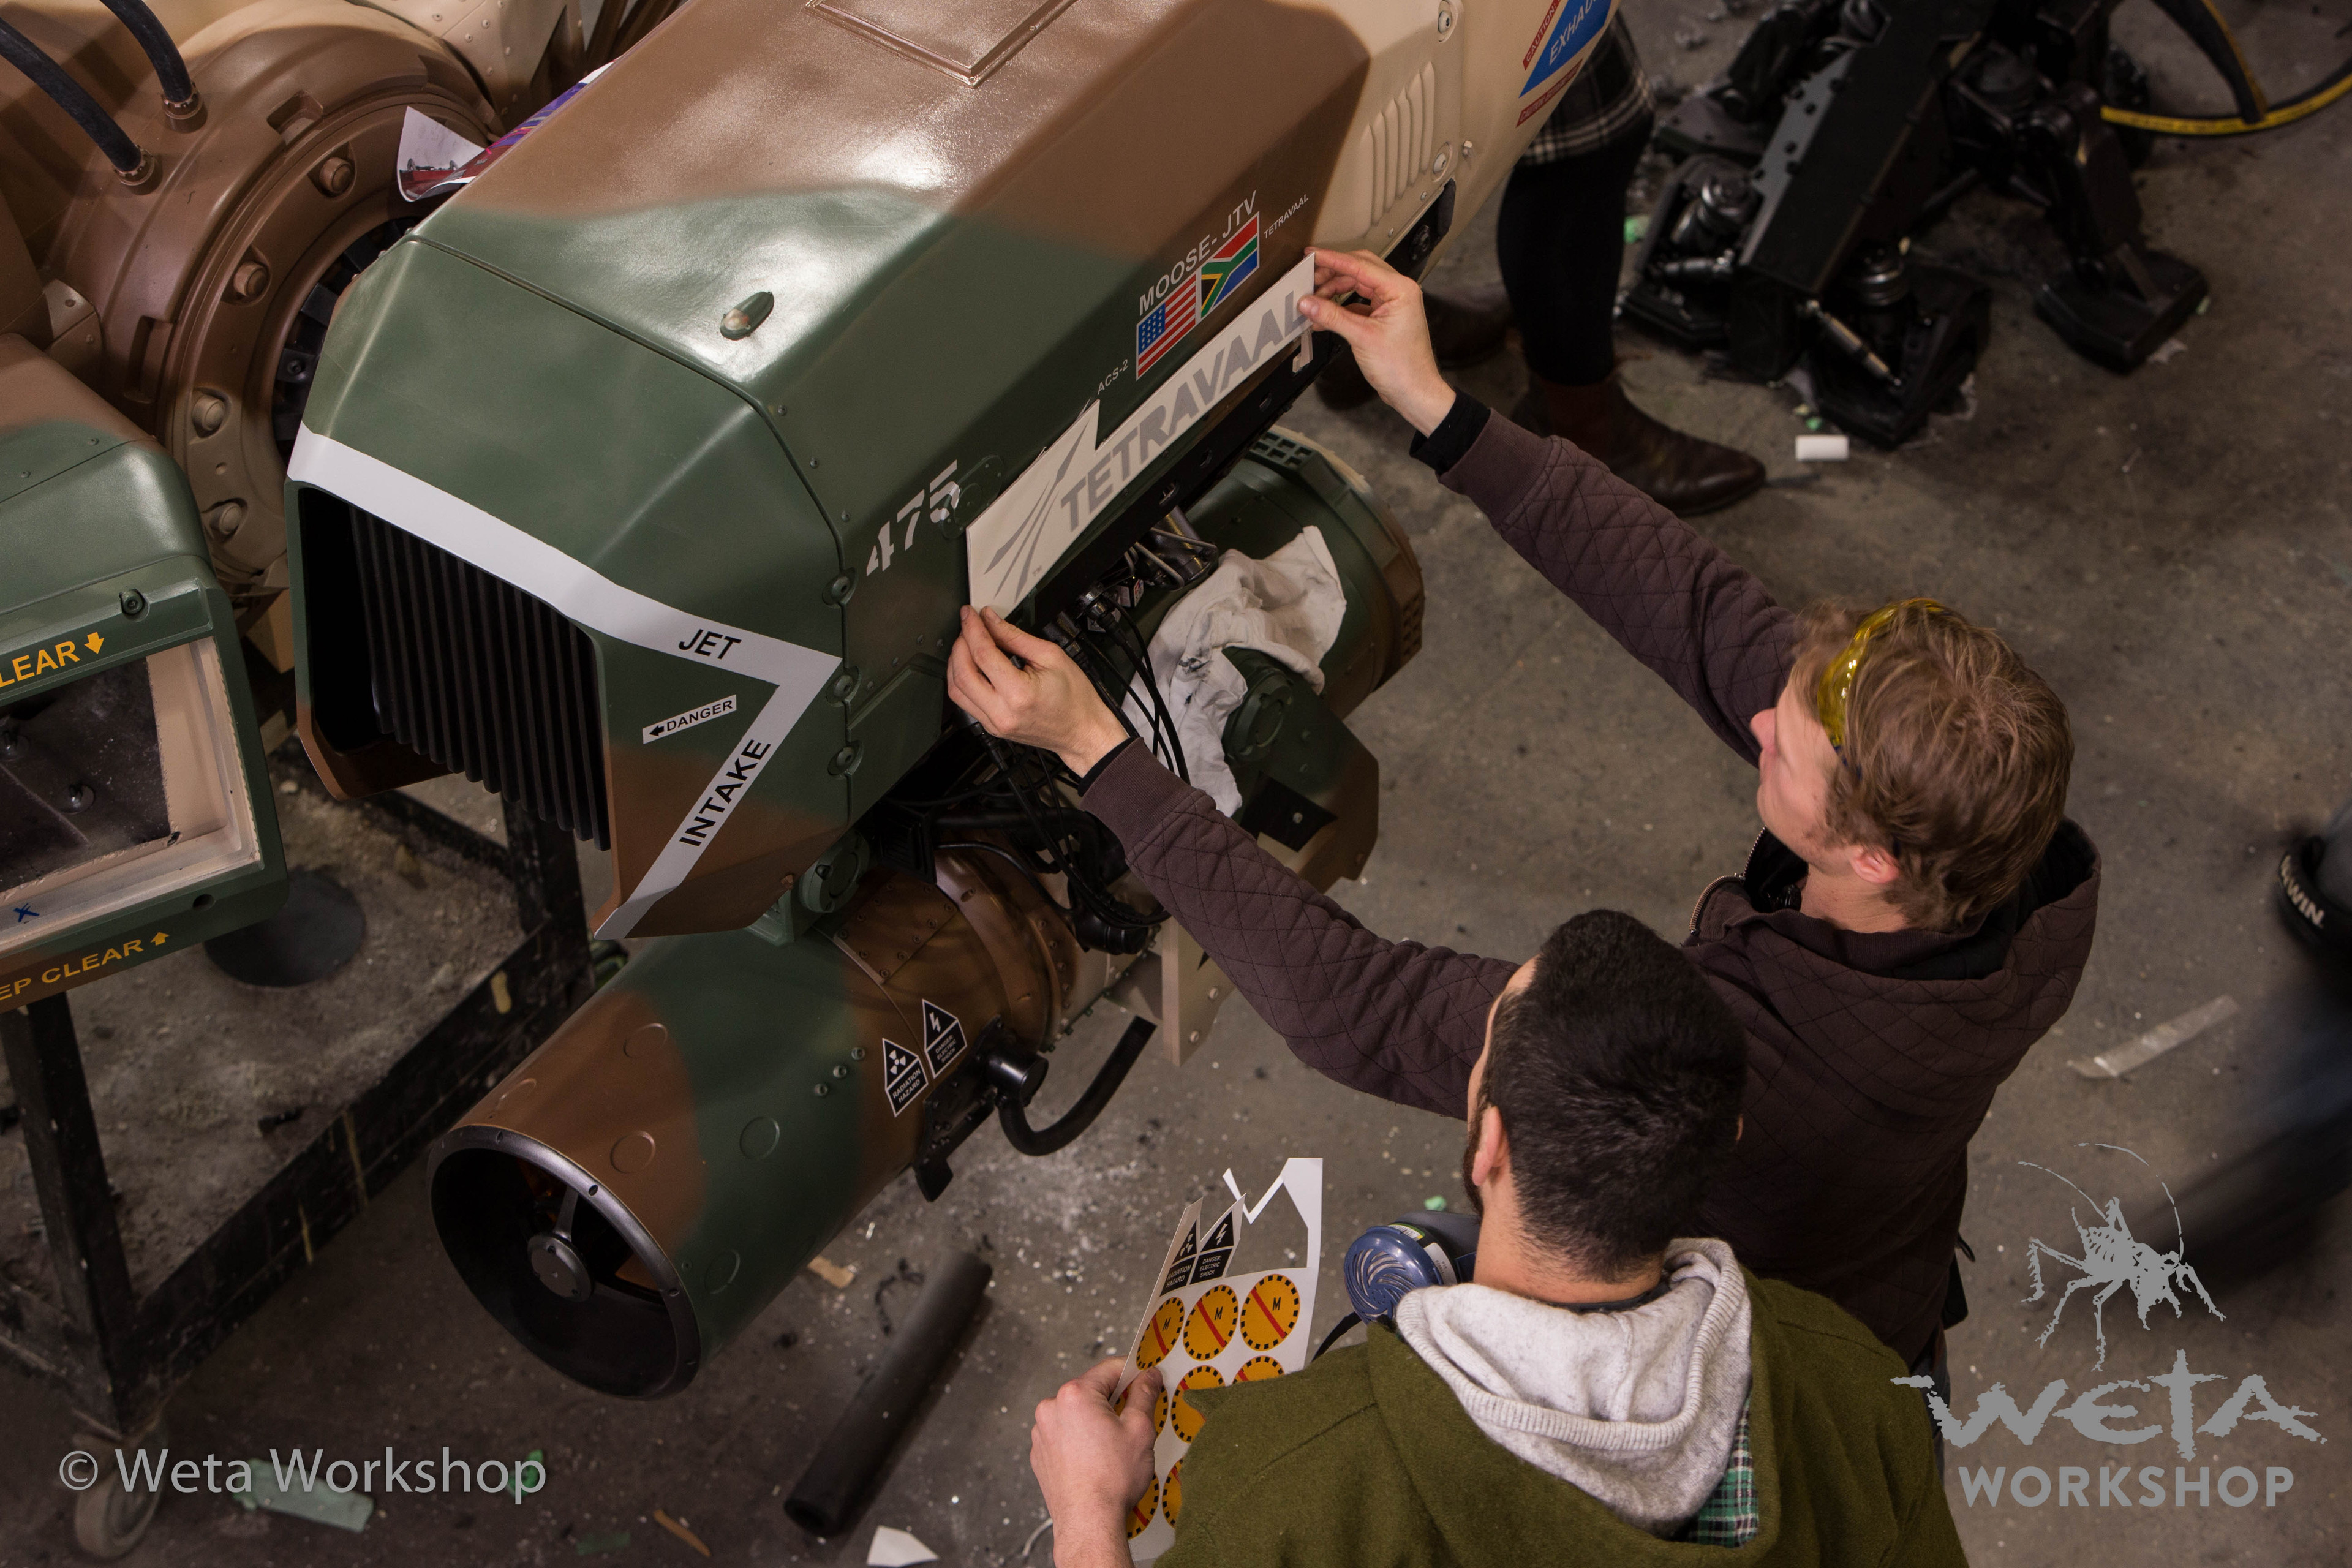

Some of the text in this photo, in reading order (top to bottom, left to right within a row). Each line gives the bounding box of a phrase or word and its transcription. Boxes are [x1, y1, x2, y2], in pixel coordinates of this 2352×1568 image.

[1526, 2, 1557, 62] CAUTION:
[1549, 0, 1596, 66] EXHAU
[1264, 194, 1309, 239] TETRAVAAL
[1097, 359, 1128, 395] ACS-2
[1061, 291, 1310, 532] TETRAVAAL
[866, 459, 960, 576] 475
[678, 629, 742, 660] JET
[666, 699, 733, 732] DANGER
[679, 739, 771, 846] INTAKE
[42, 940, 144, 984] CLEAR
[892, 1068, 921, 1099] RADIATION
[899, 1079, 920, 1103] HAZARD
[1166, 1275, 1185, 1287] HAZARD
[1167, 1264, 1191, 1280] RADIATION
[1199, 1262, 1220, 1272] ELECTRIC
[1215, 1306, 1223, 1321] M
[1272, 1297, 1281, 1311] M
[1162, 1317, 1171, 1331] M
